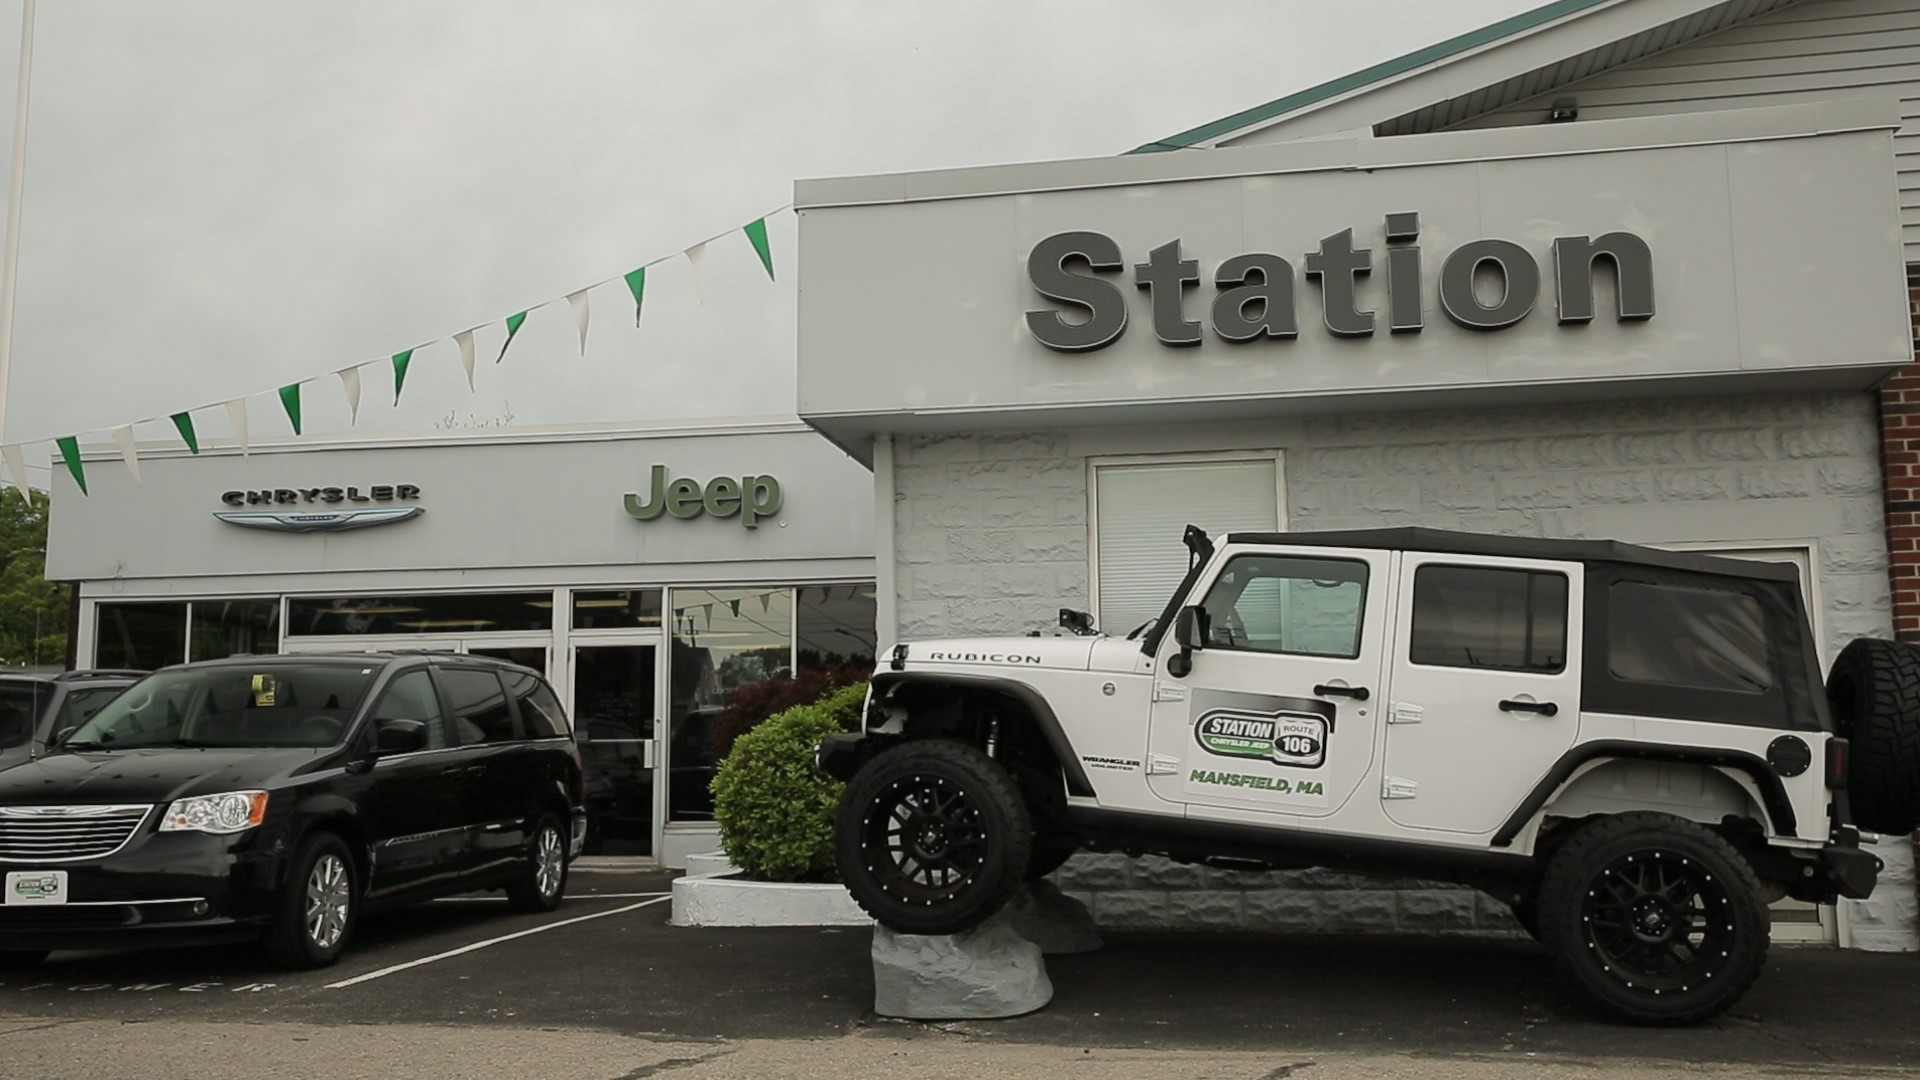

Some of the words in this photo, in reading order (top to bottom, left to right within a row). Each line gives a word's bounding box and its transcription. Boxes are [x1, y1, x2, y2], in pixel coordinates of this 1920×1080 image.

[1026, 211, 1656, 353] Station
[221, 484, 421, 506] CHRYSLER
[624, 463, 783, 530] Jeep
[930, 652, 1041, 664] RUBICON
[1210, 717, 1274, 739] STATION
[1283, 724, 1315, 735] ROUTE
[1210, 737, 1250, 748] CHRYSLER
[1250, 741, 1271, 750] JEEP
[1282, 736, 1312, 753] 106
[1082, 755, 1141, 767] WRANGLER
[1189, 769, 1292, 794] MANSFIELD,
[1296, 780, 1324, 795] MA
